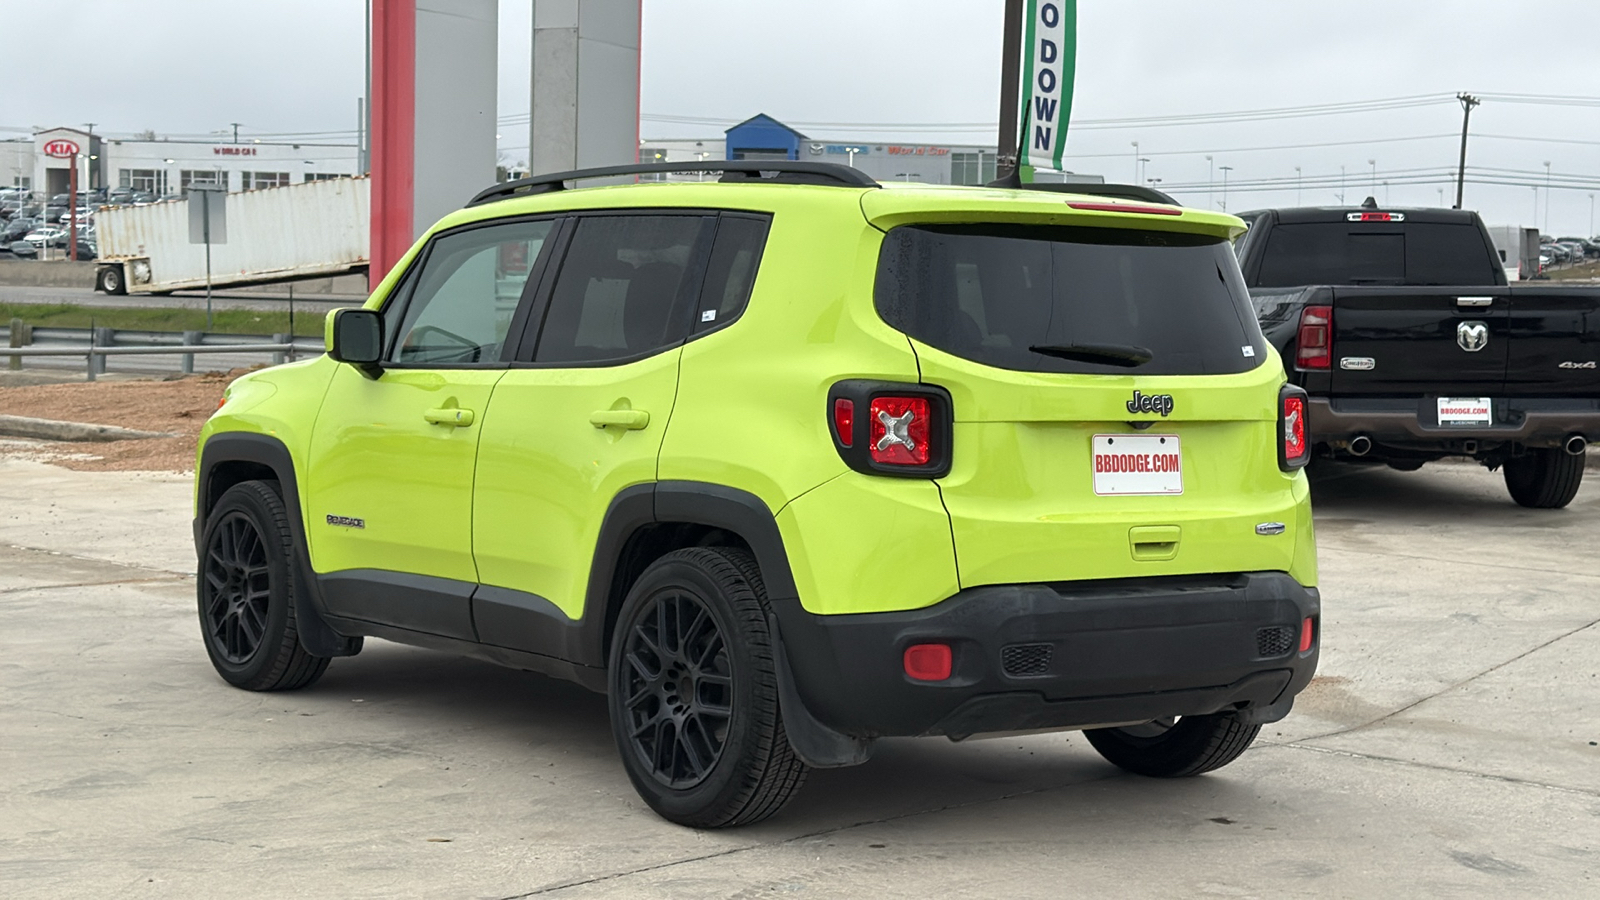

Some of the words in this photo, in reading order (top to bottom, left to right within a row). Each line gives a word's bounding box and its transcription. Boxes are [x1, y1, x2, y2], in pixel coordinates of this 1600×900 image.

[1041, 0, 1059, 28] O
[1034, 38, 1058, 151] DOWN
[50, 143, 73, 154] KIA
[928, 146, 951, 156] Car
[1558, 360, 1597, 370] 4x4
[1127, 390, 1174, 416] Jeep
[1440, 407, 1488, 415] BBDODGE.COM
[1095, 453, 1179, 473] BBDODGE.COM
